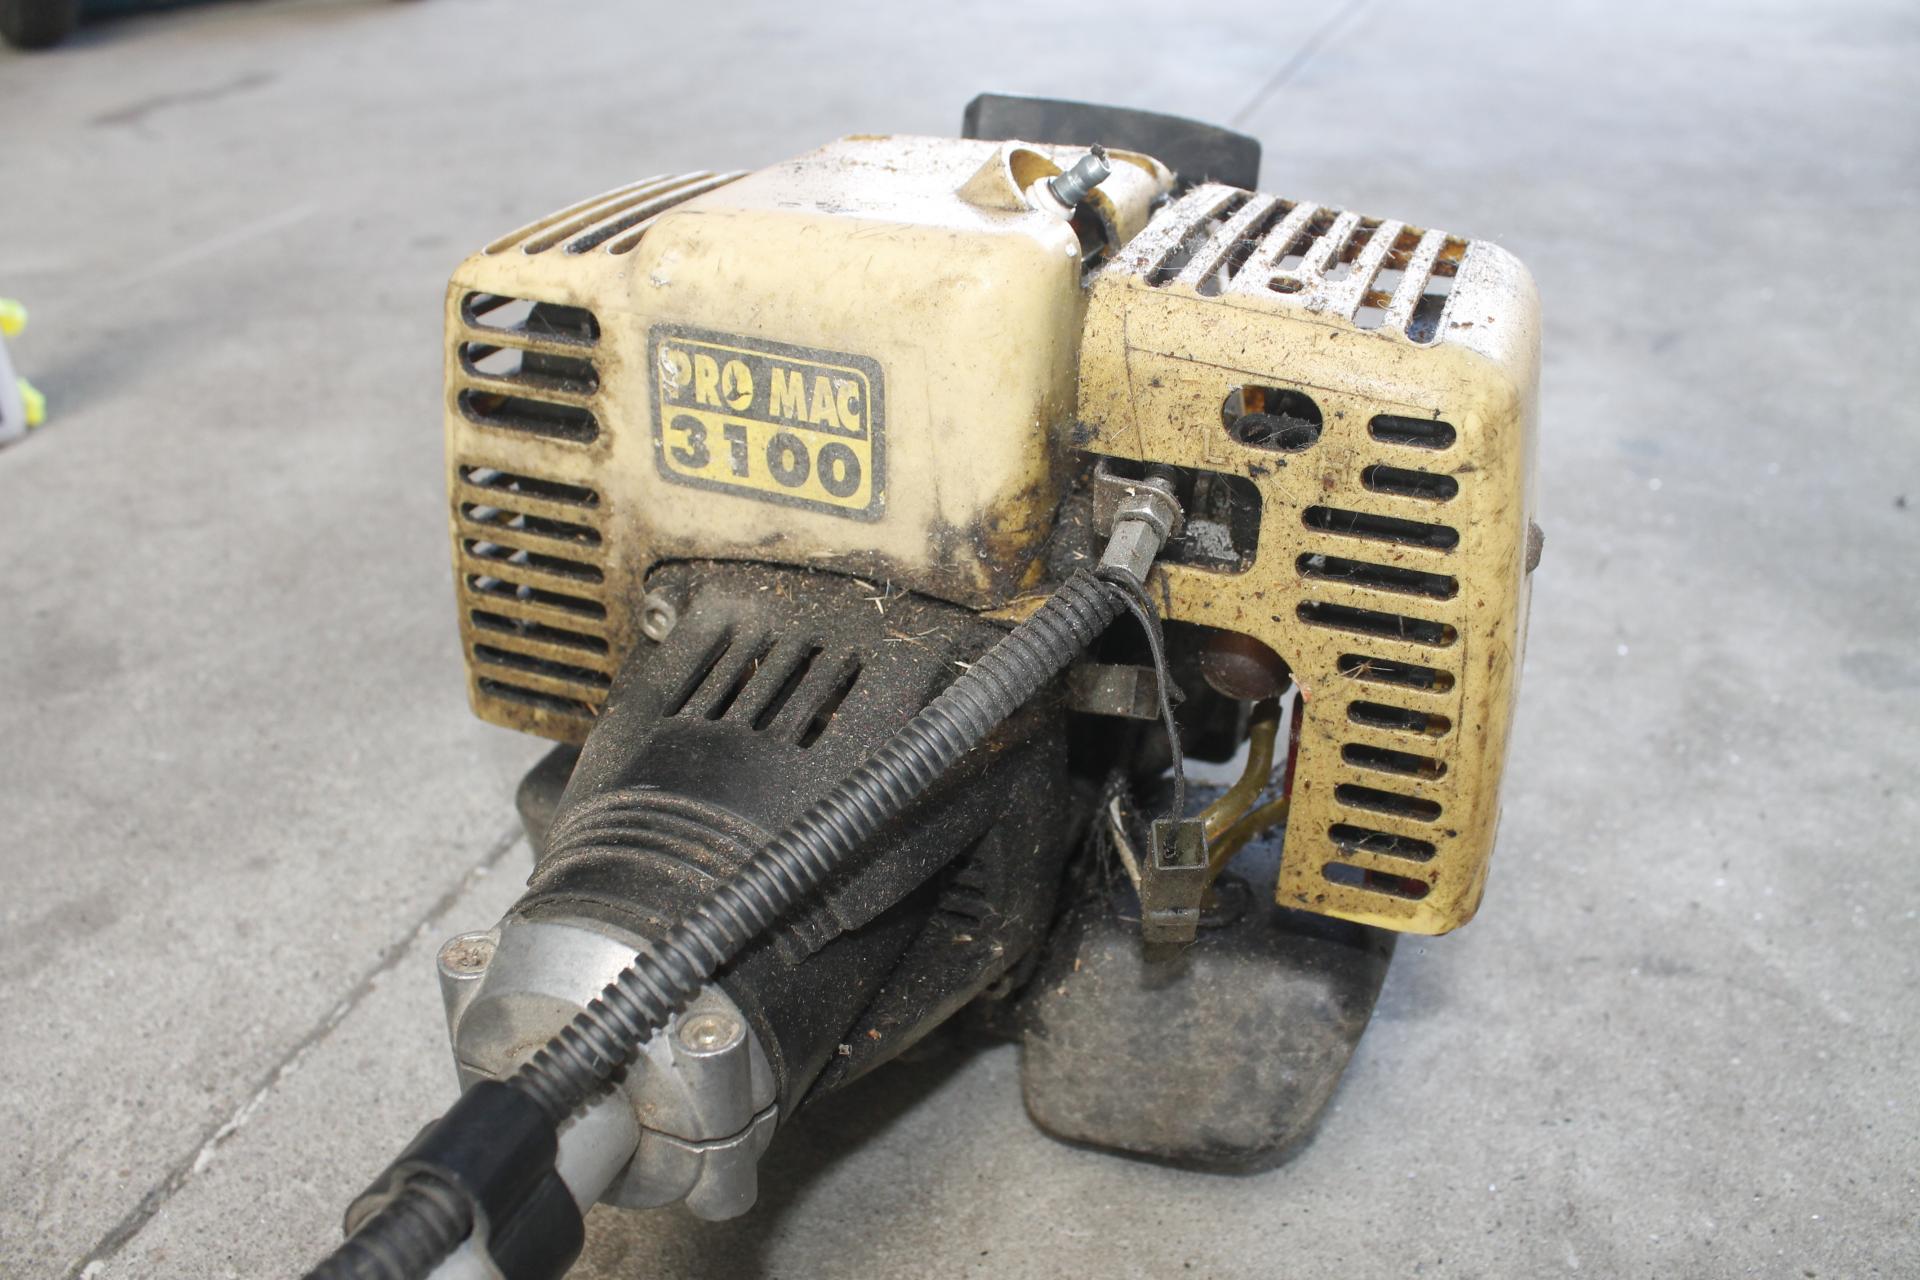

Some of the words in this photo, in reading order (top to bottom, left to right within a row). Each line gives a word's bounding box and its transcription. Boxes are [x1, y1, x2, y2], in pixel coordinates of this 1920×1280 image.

[664, 348, 753, 412] PRO
[768, 366, 861, 432] MAC
[669, 413, 862, 498] 3100
